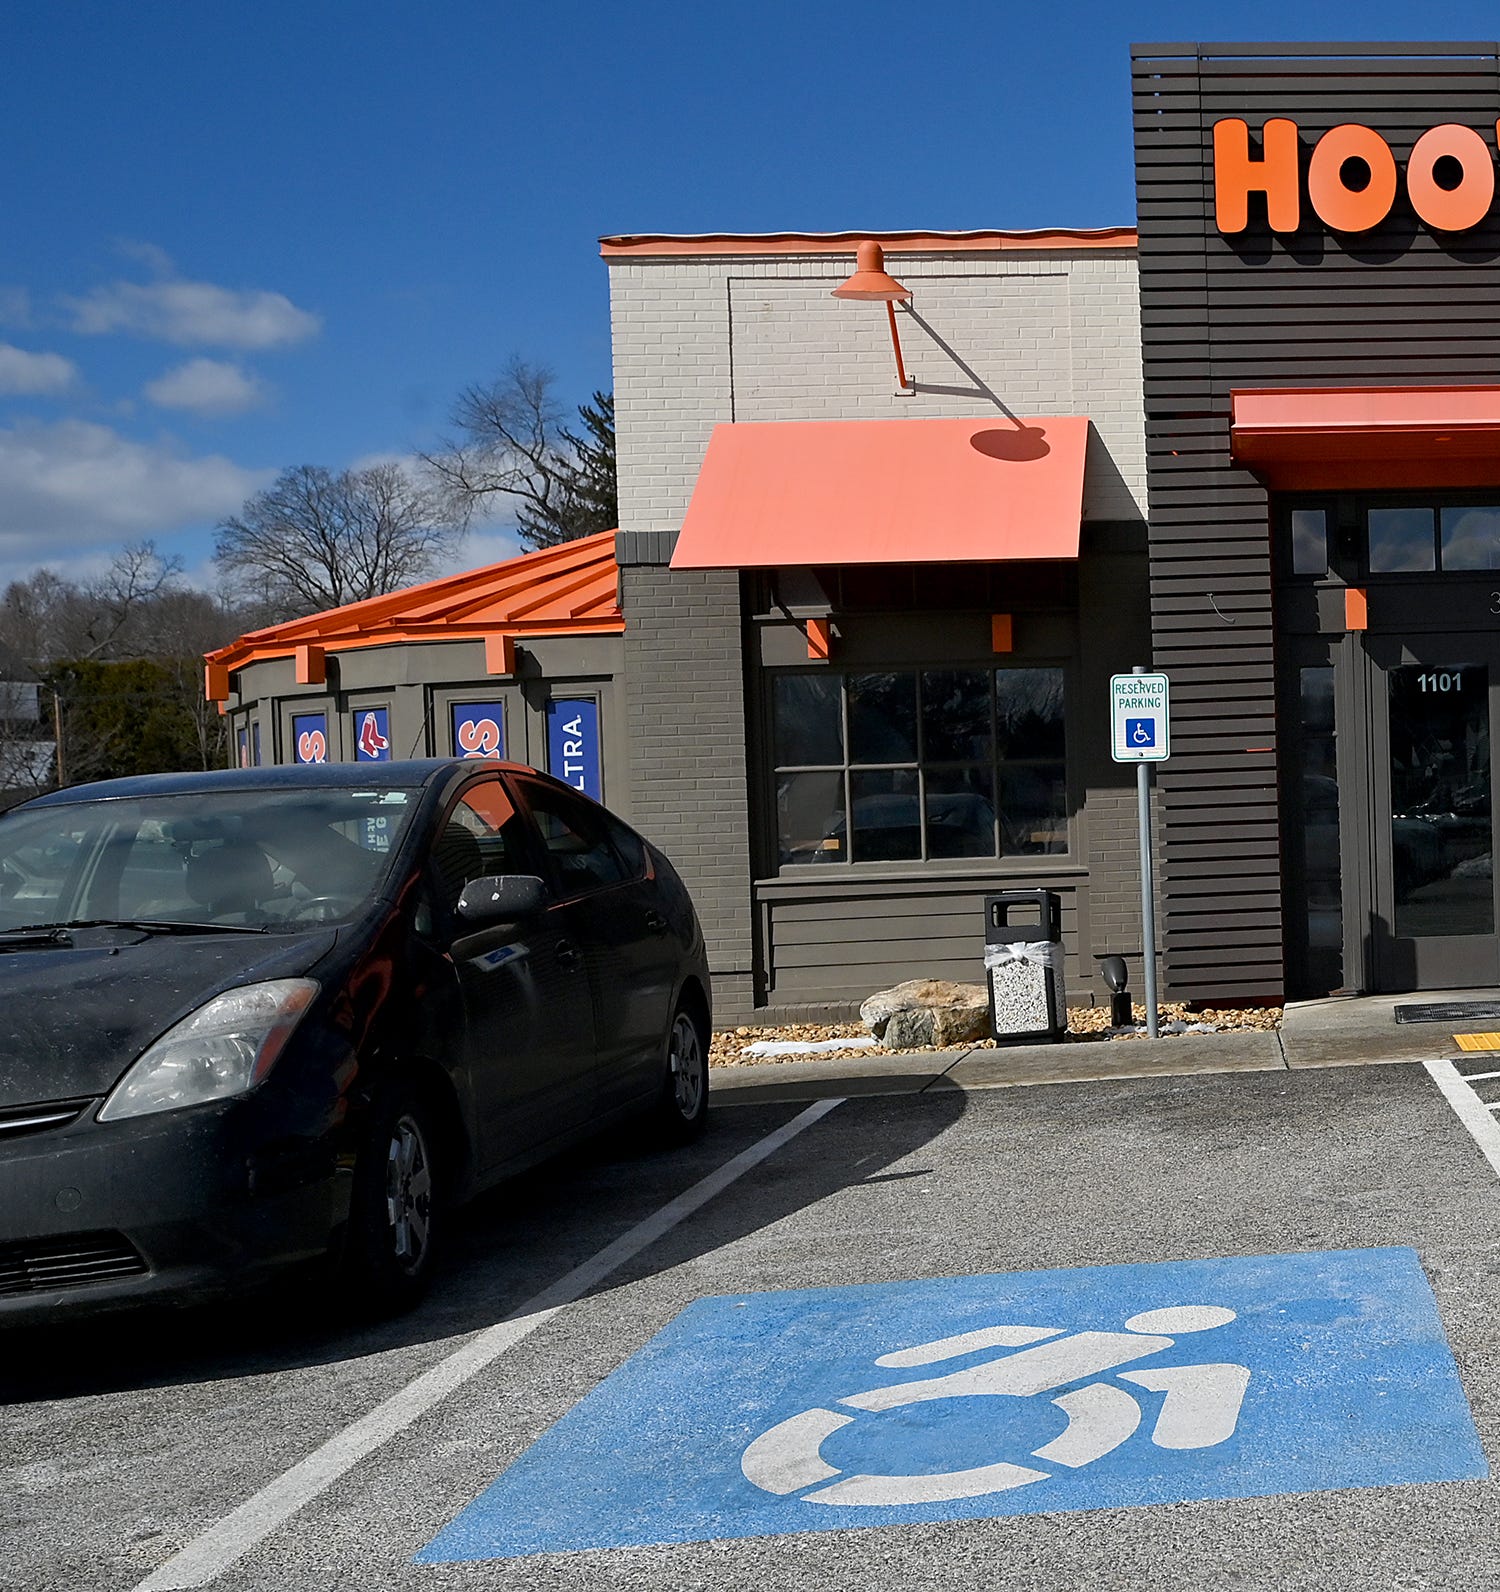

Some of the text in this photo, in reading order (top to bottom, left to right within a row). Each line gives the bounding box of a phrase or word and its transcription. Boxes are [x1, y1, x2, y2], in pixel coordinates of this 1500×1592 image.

[1115, 683, 1164, 694] RESERVED
[1417, 672, 1462, 693] 1101
[1119, 697, 1161, 709] PARKING
[562, 714, 584, 791] LTRA
